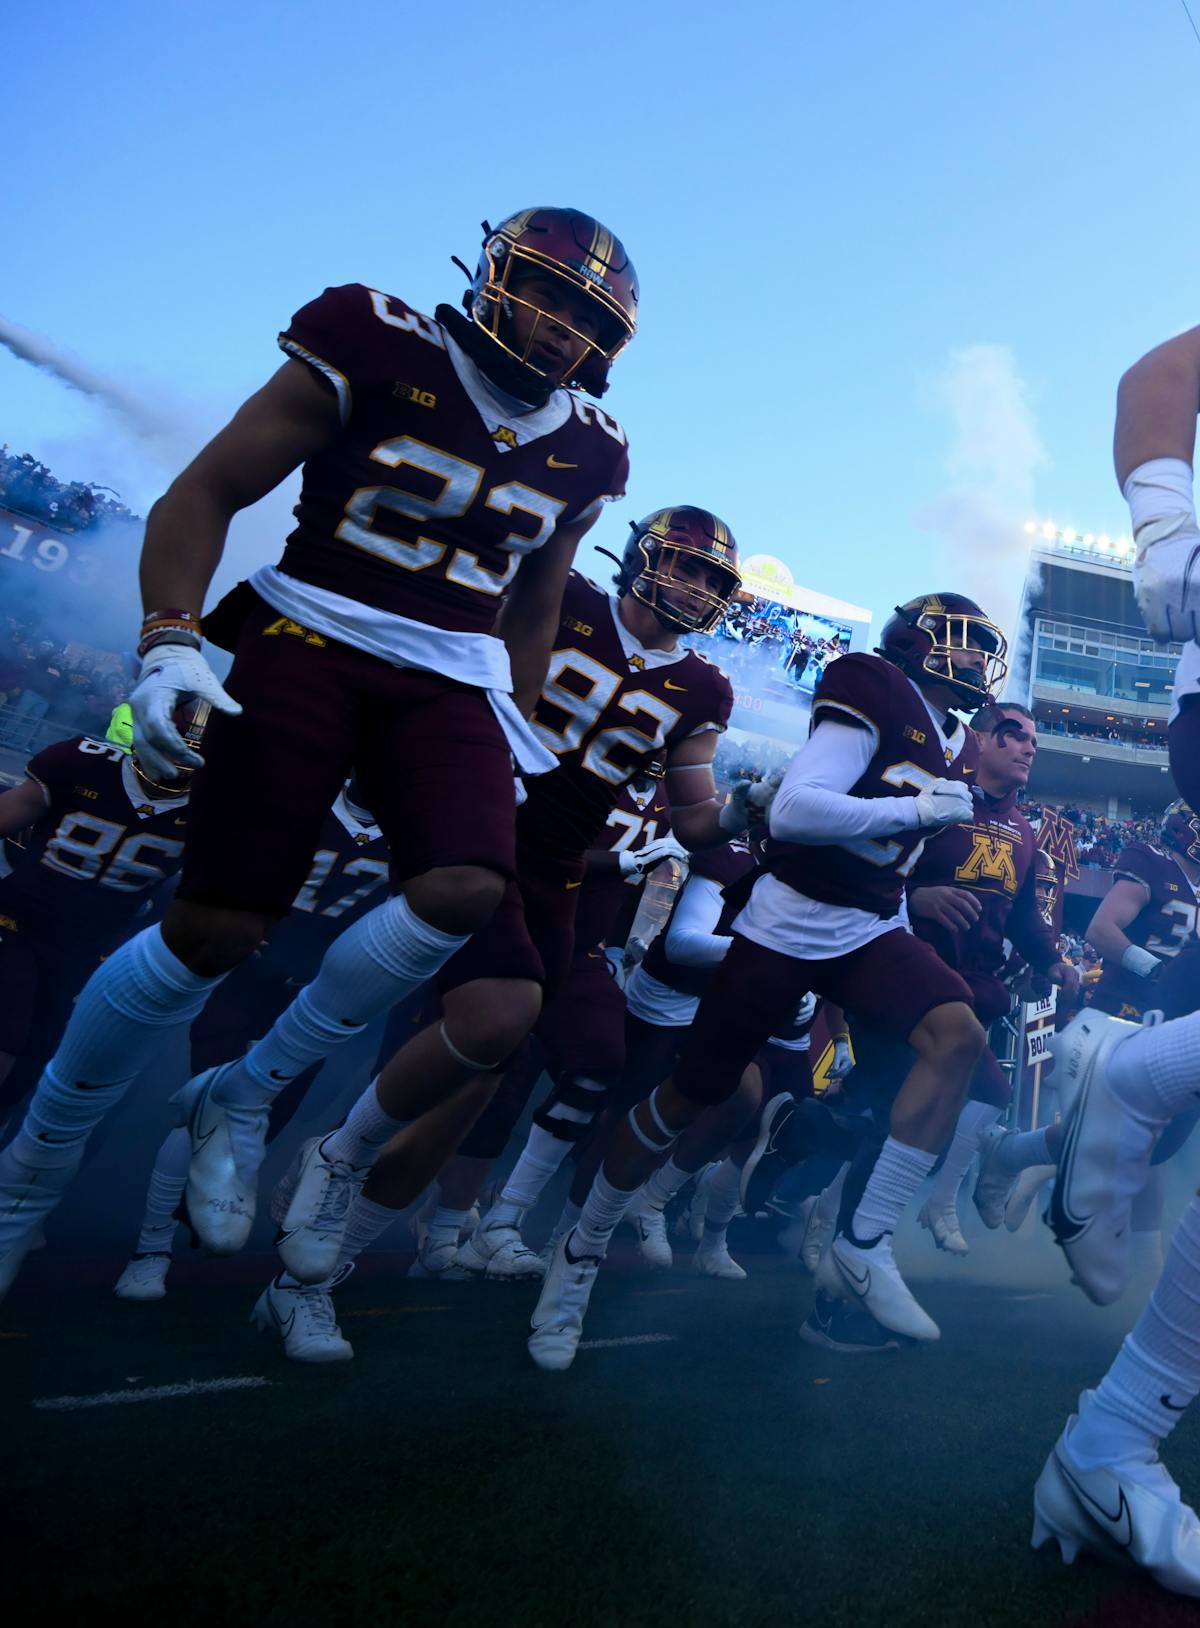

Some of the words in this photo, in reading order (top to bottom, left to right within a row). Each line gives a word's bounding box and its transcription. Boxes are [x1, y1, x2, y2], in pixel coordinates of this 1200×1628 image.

[335, 434, 568, 597] 23
[528, 646, 684, 788] 92
[40, 810, 187, 893] 86
[605, 808, 660, 882] 71
[954, 832, 1019, 895] M
[1036, 807, 1081, 881] M
[290, 849, 390, 919] 17
